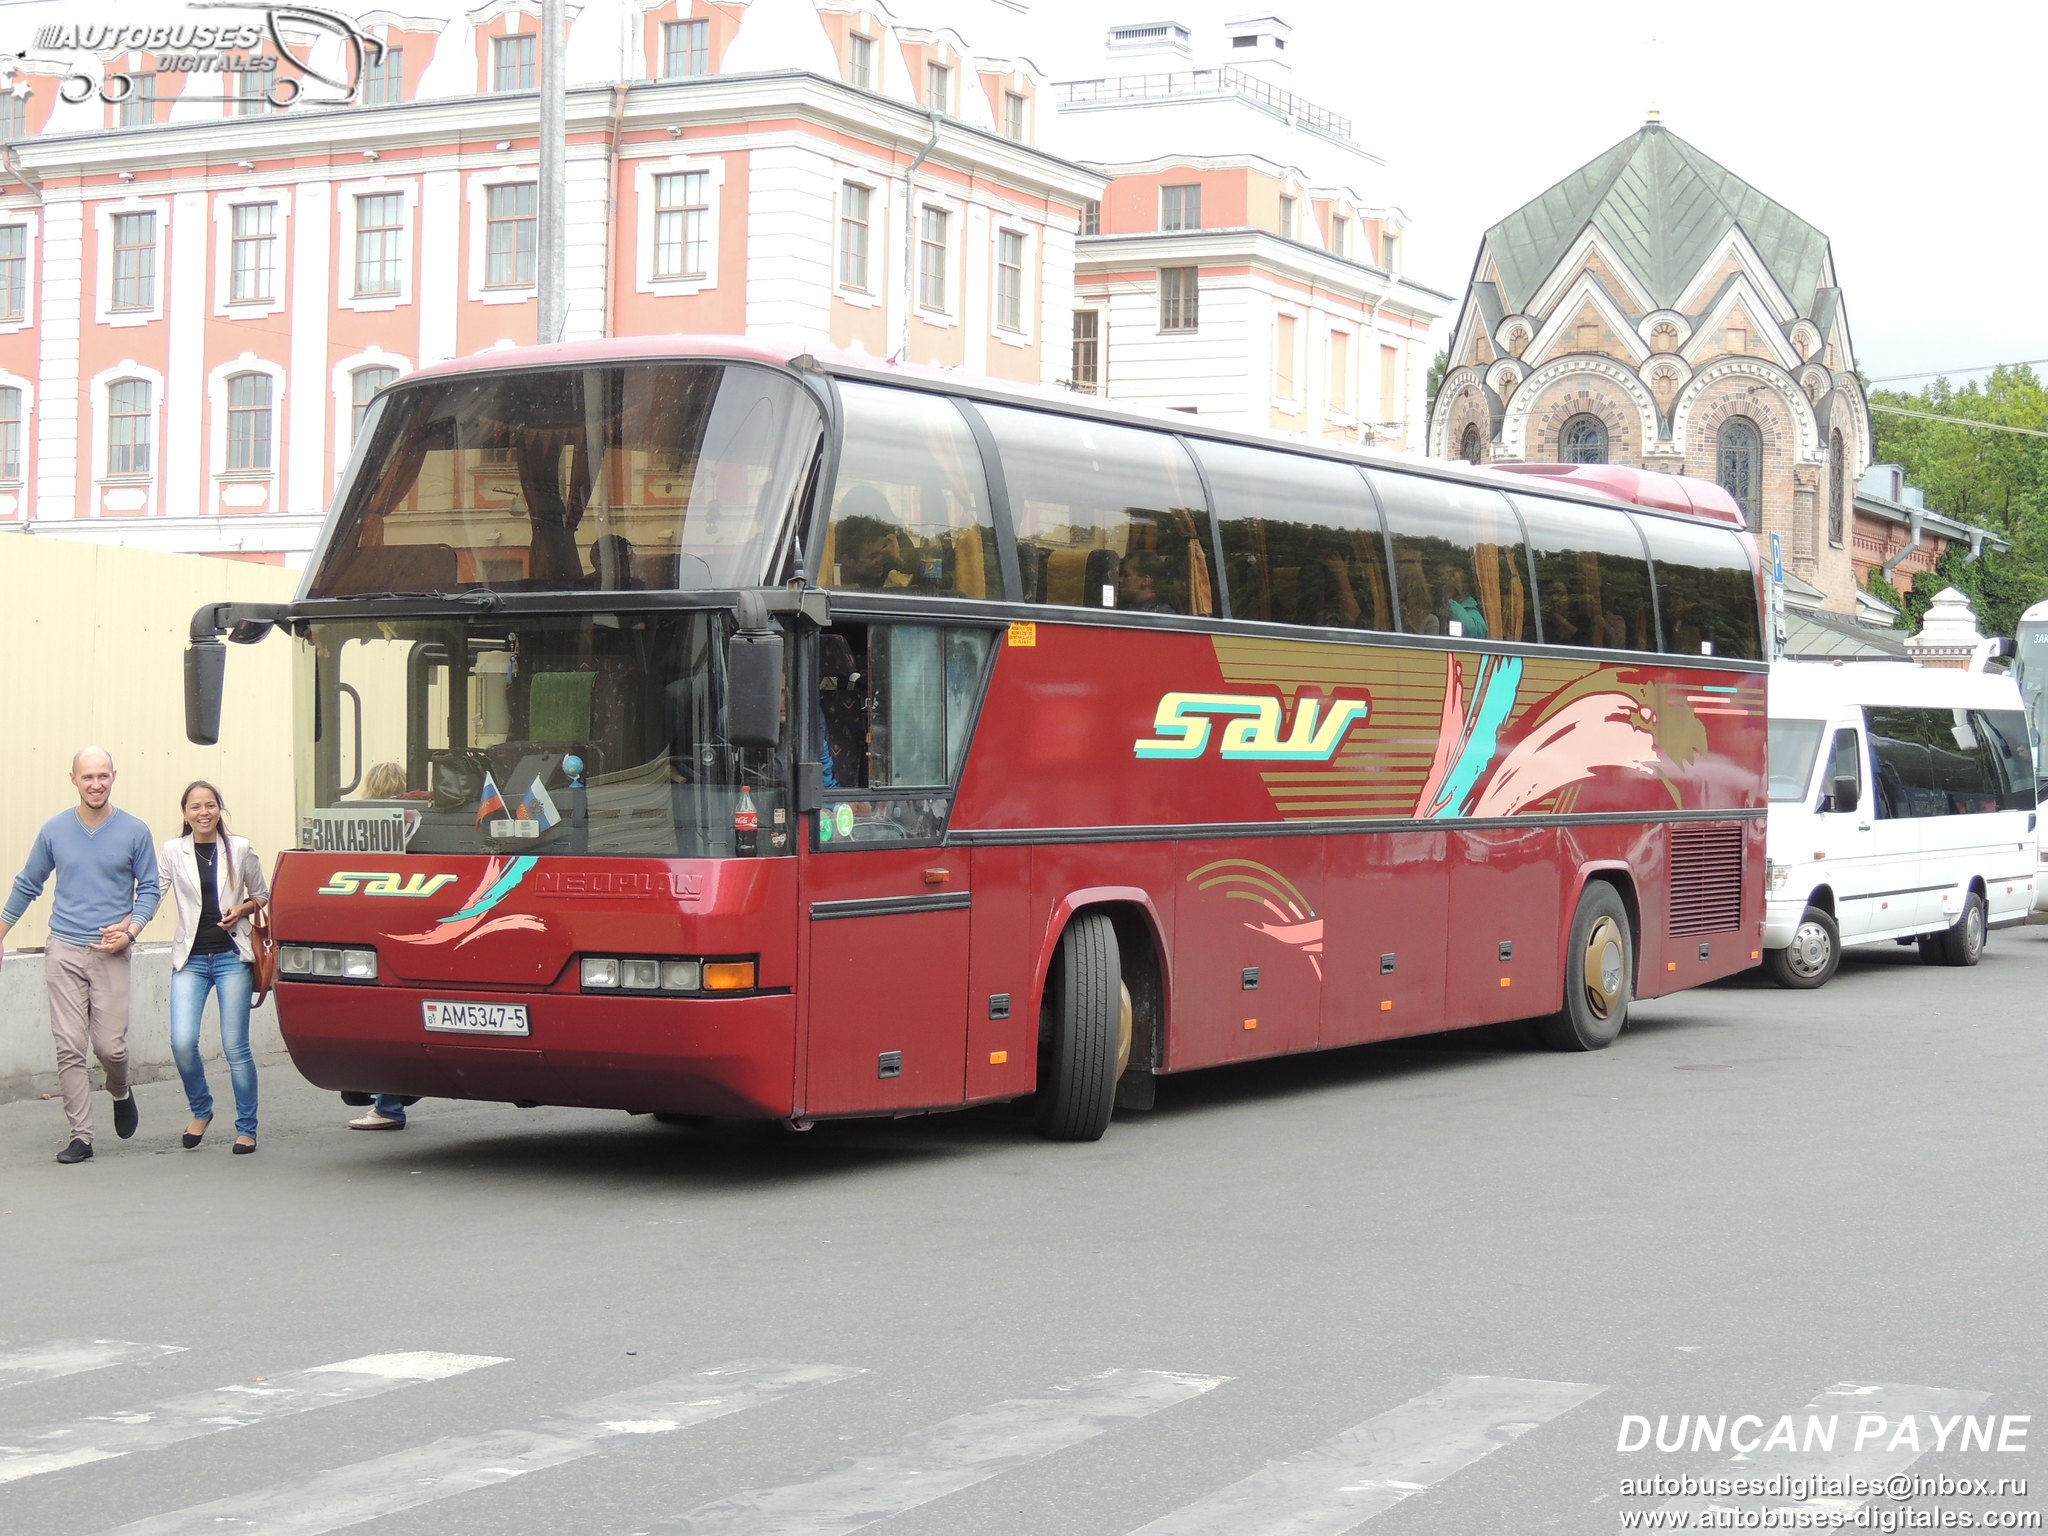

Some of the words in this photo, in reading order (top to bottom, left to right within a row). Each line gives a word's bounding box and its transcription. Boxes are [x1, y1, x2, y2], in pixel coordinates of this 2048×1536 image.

[313, 813, 404, 852] ЗАКАЗНОЙ
[535, 872, 703, 895] NEOPLAN
[441, 1005, 525, 1029] AM5347-5
